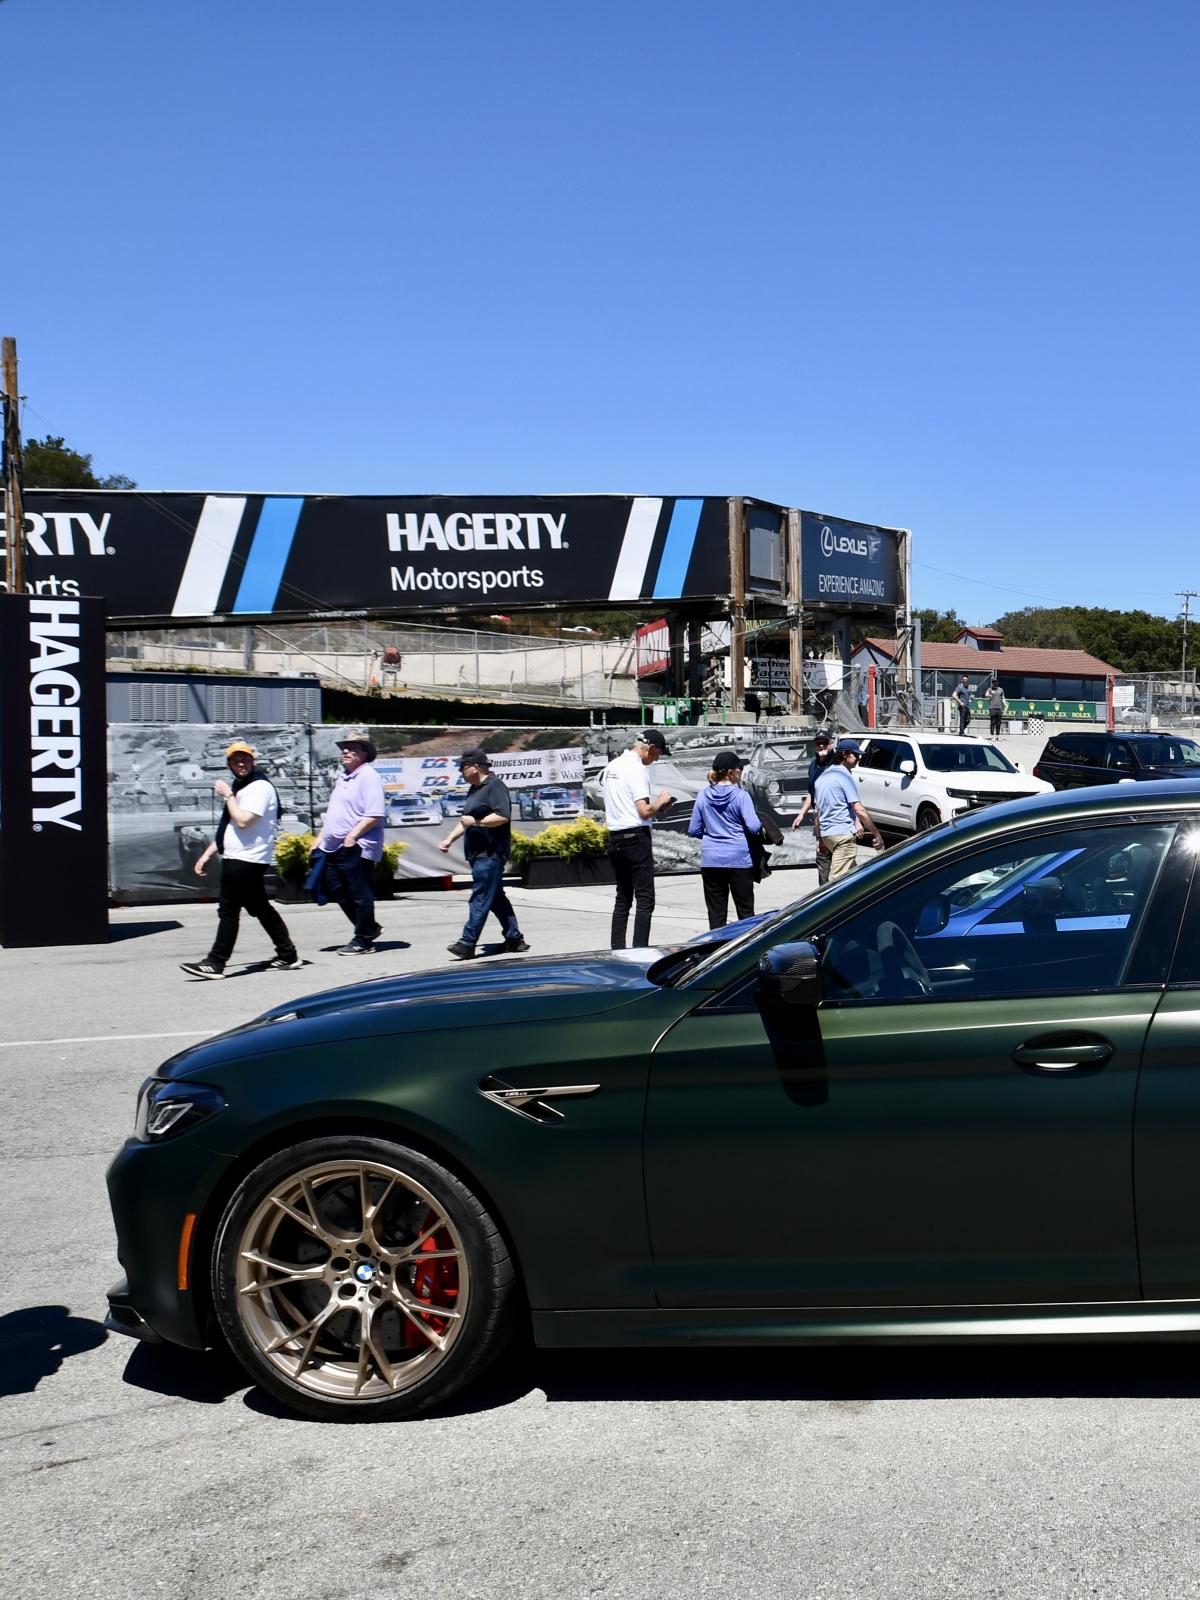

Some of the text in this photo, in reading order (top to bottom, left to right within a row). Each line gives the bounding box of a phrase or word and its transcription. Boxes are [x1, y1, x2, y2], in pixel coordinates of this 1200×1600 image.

[386, 512, 567, 551] HAGERTY
[833, 535, 868, 556] LEXUS
[390, 565, 544, 595] Motorsports
[818, 574, 885, 597] EXPERIENCE AMAZING
[29, 599, 82, 831] HAGERTY
[421, 758, 449, 768] D2
[422, 775, 450, 786] D2
